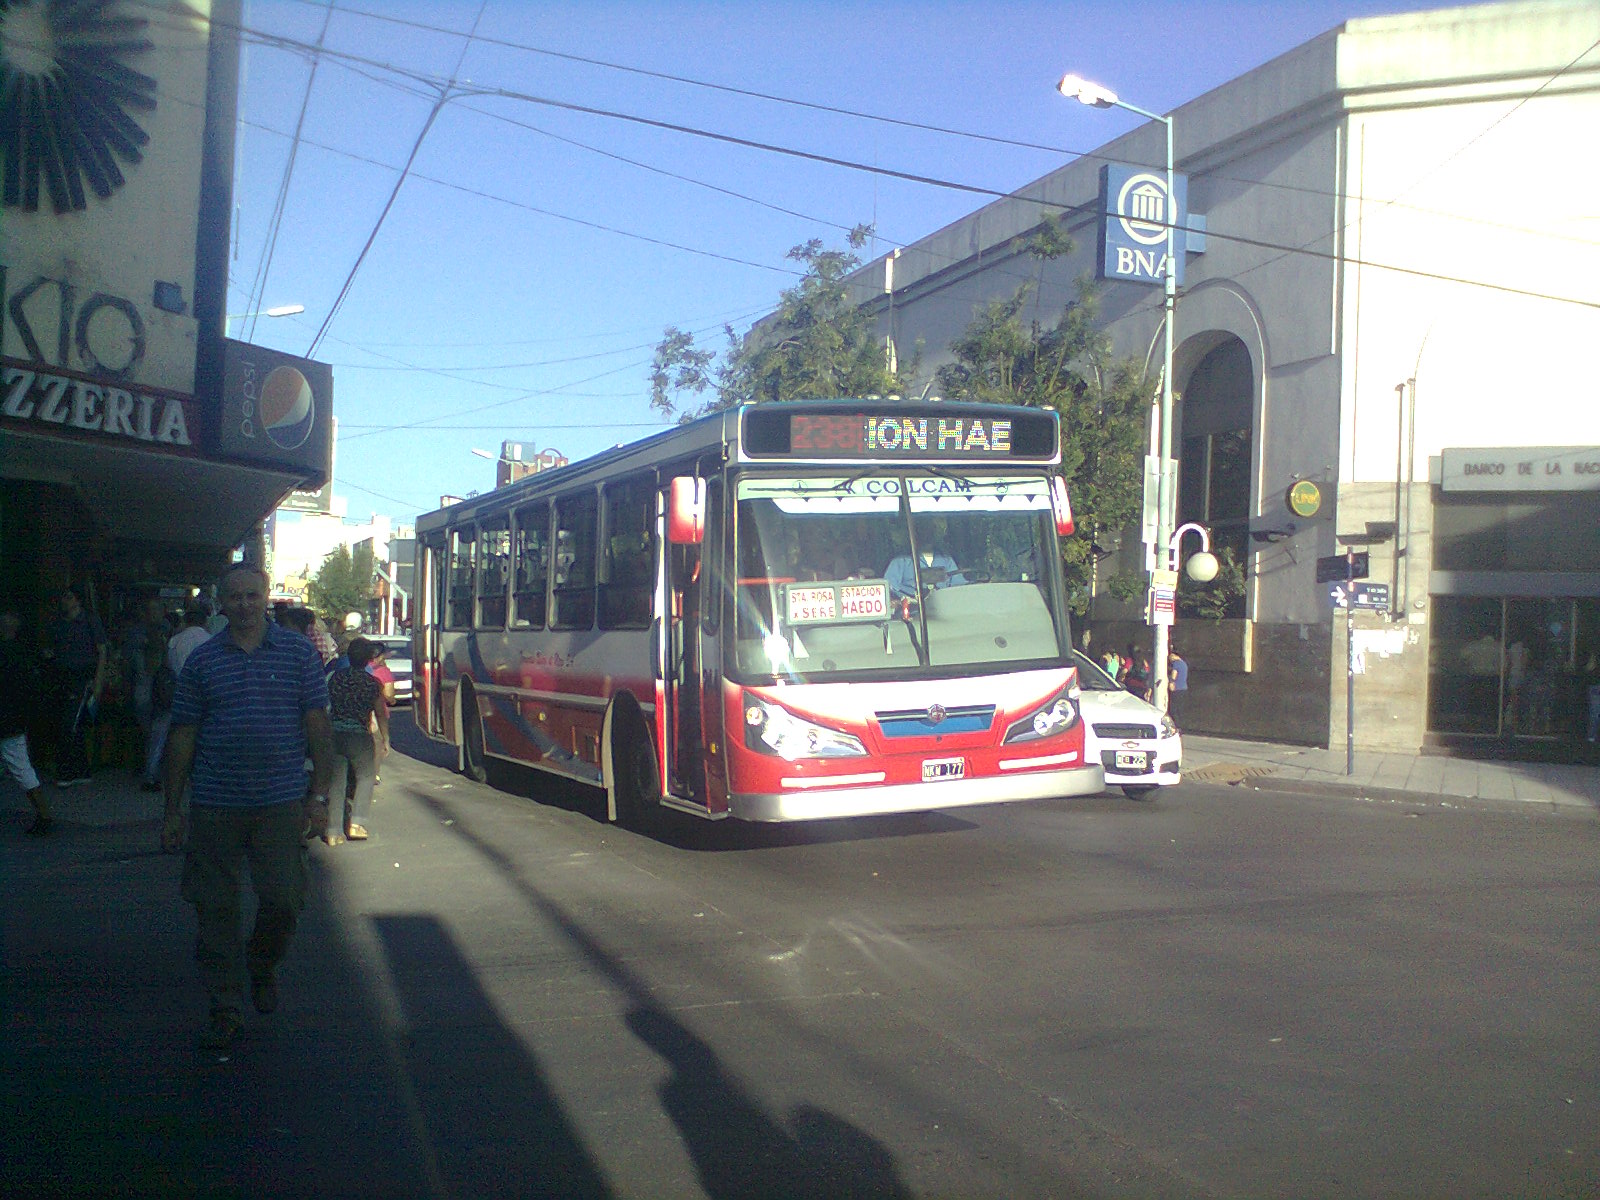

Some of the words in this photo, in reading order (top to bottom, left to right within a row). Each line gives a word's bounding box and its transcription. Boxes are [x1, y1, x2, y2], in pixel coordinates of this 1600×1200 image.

[937, 420, 1012, 451] HAE
[1517, 461, 1534, 475] DE
[1545, 462, 1562, 475] LA
[841, 599, 883, 615] HAEDO
